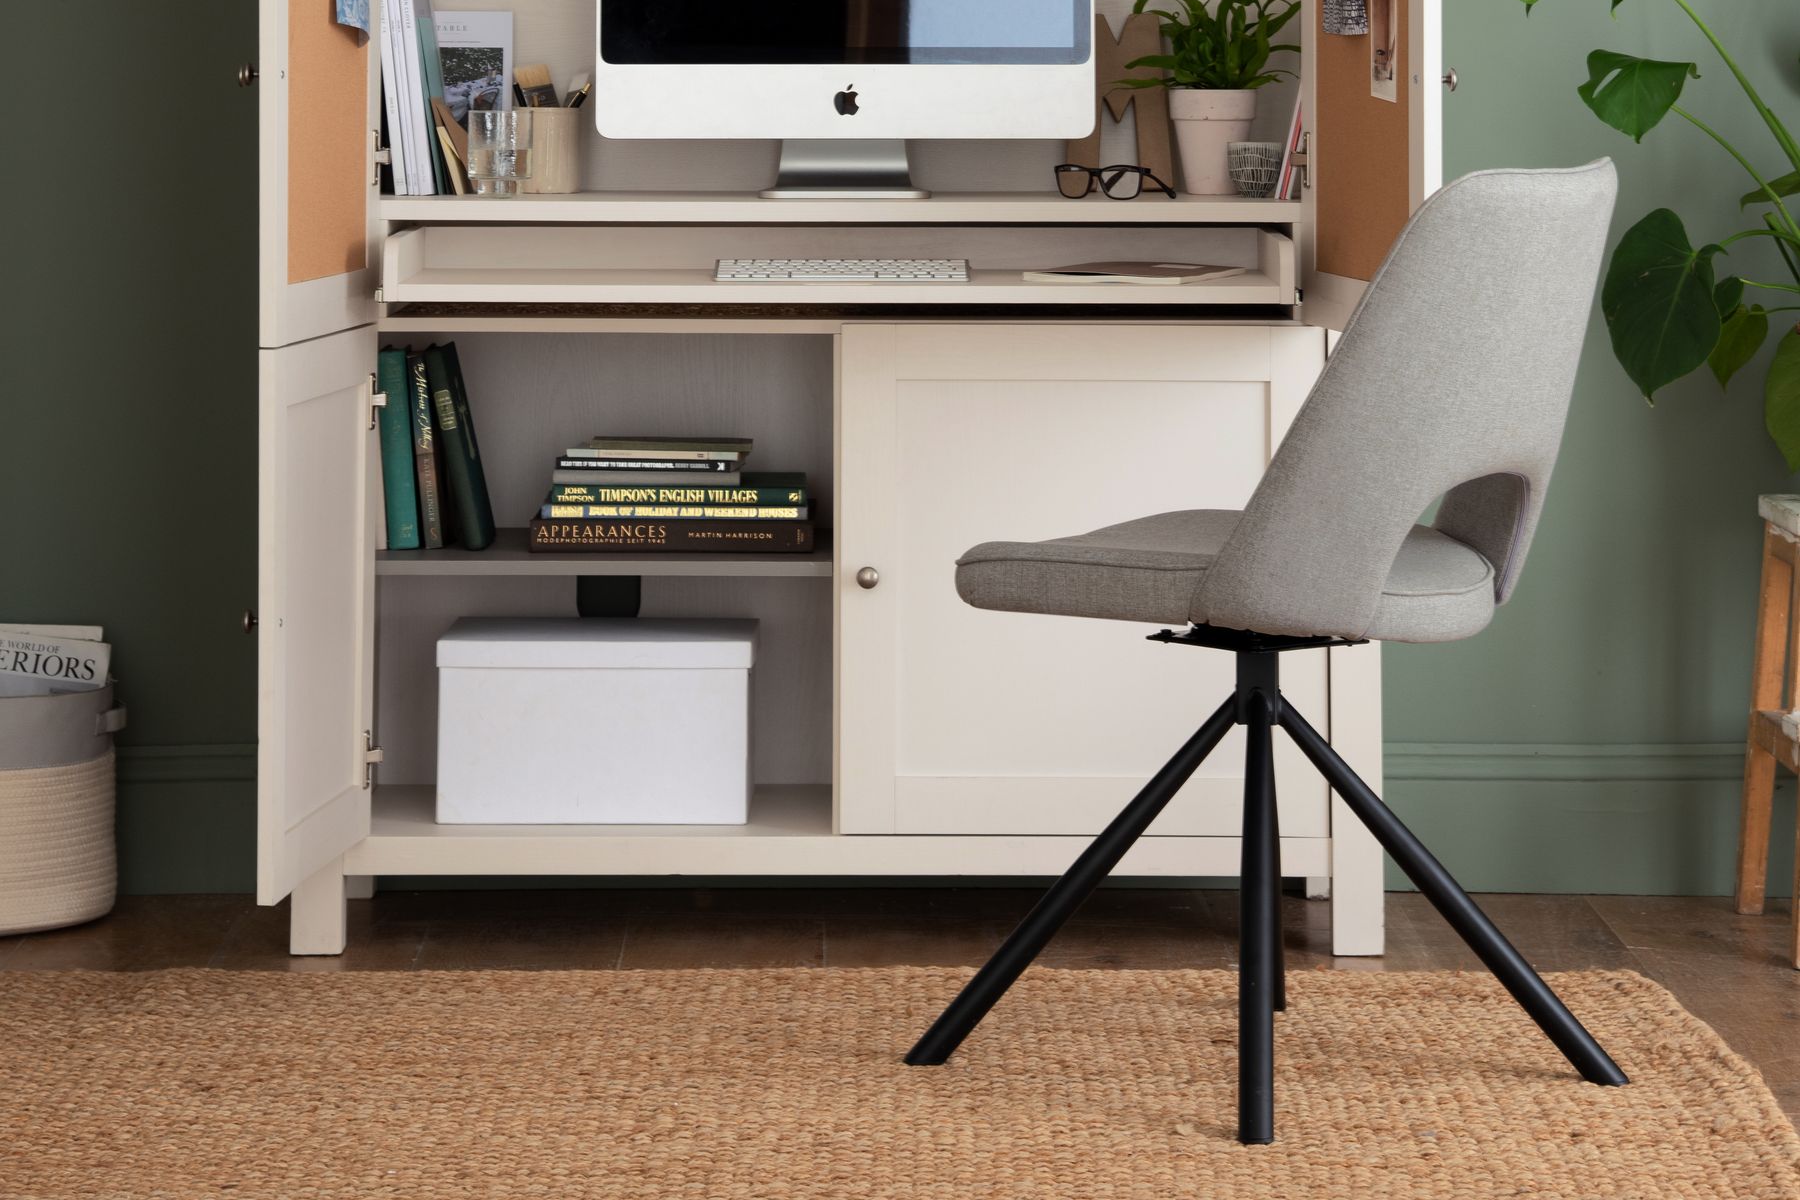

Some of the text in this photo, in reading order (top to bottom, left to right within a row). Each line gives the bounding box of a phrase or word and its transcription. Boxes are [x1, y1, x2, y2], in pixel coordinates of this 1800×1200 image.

[564, 487, 587, 495] JOHN
[599, 488, 758, 503] TIMPSON'S ENGLISH VILLAGES
[589, 506, 618, 516] BOOK
[619, 506, 634, 516] OF
[634, 506, 679, 517] HOLIDAY
[679, 507, 703, 517] AND
[704, 507, 757, 518] WEEKEND
[758, 507, 798, 518] HOUSES
[537, 525, 667, 538] APPEARANCES
[688, 531, 773, 540] MARTIN HARRISON
[8, 640, 45, 652] WORLD
[47, 645, 62, 654] OF
